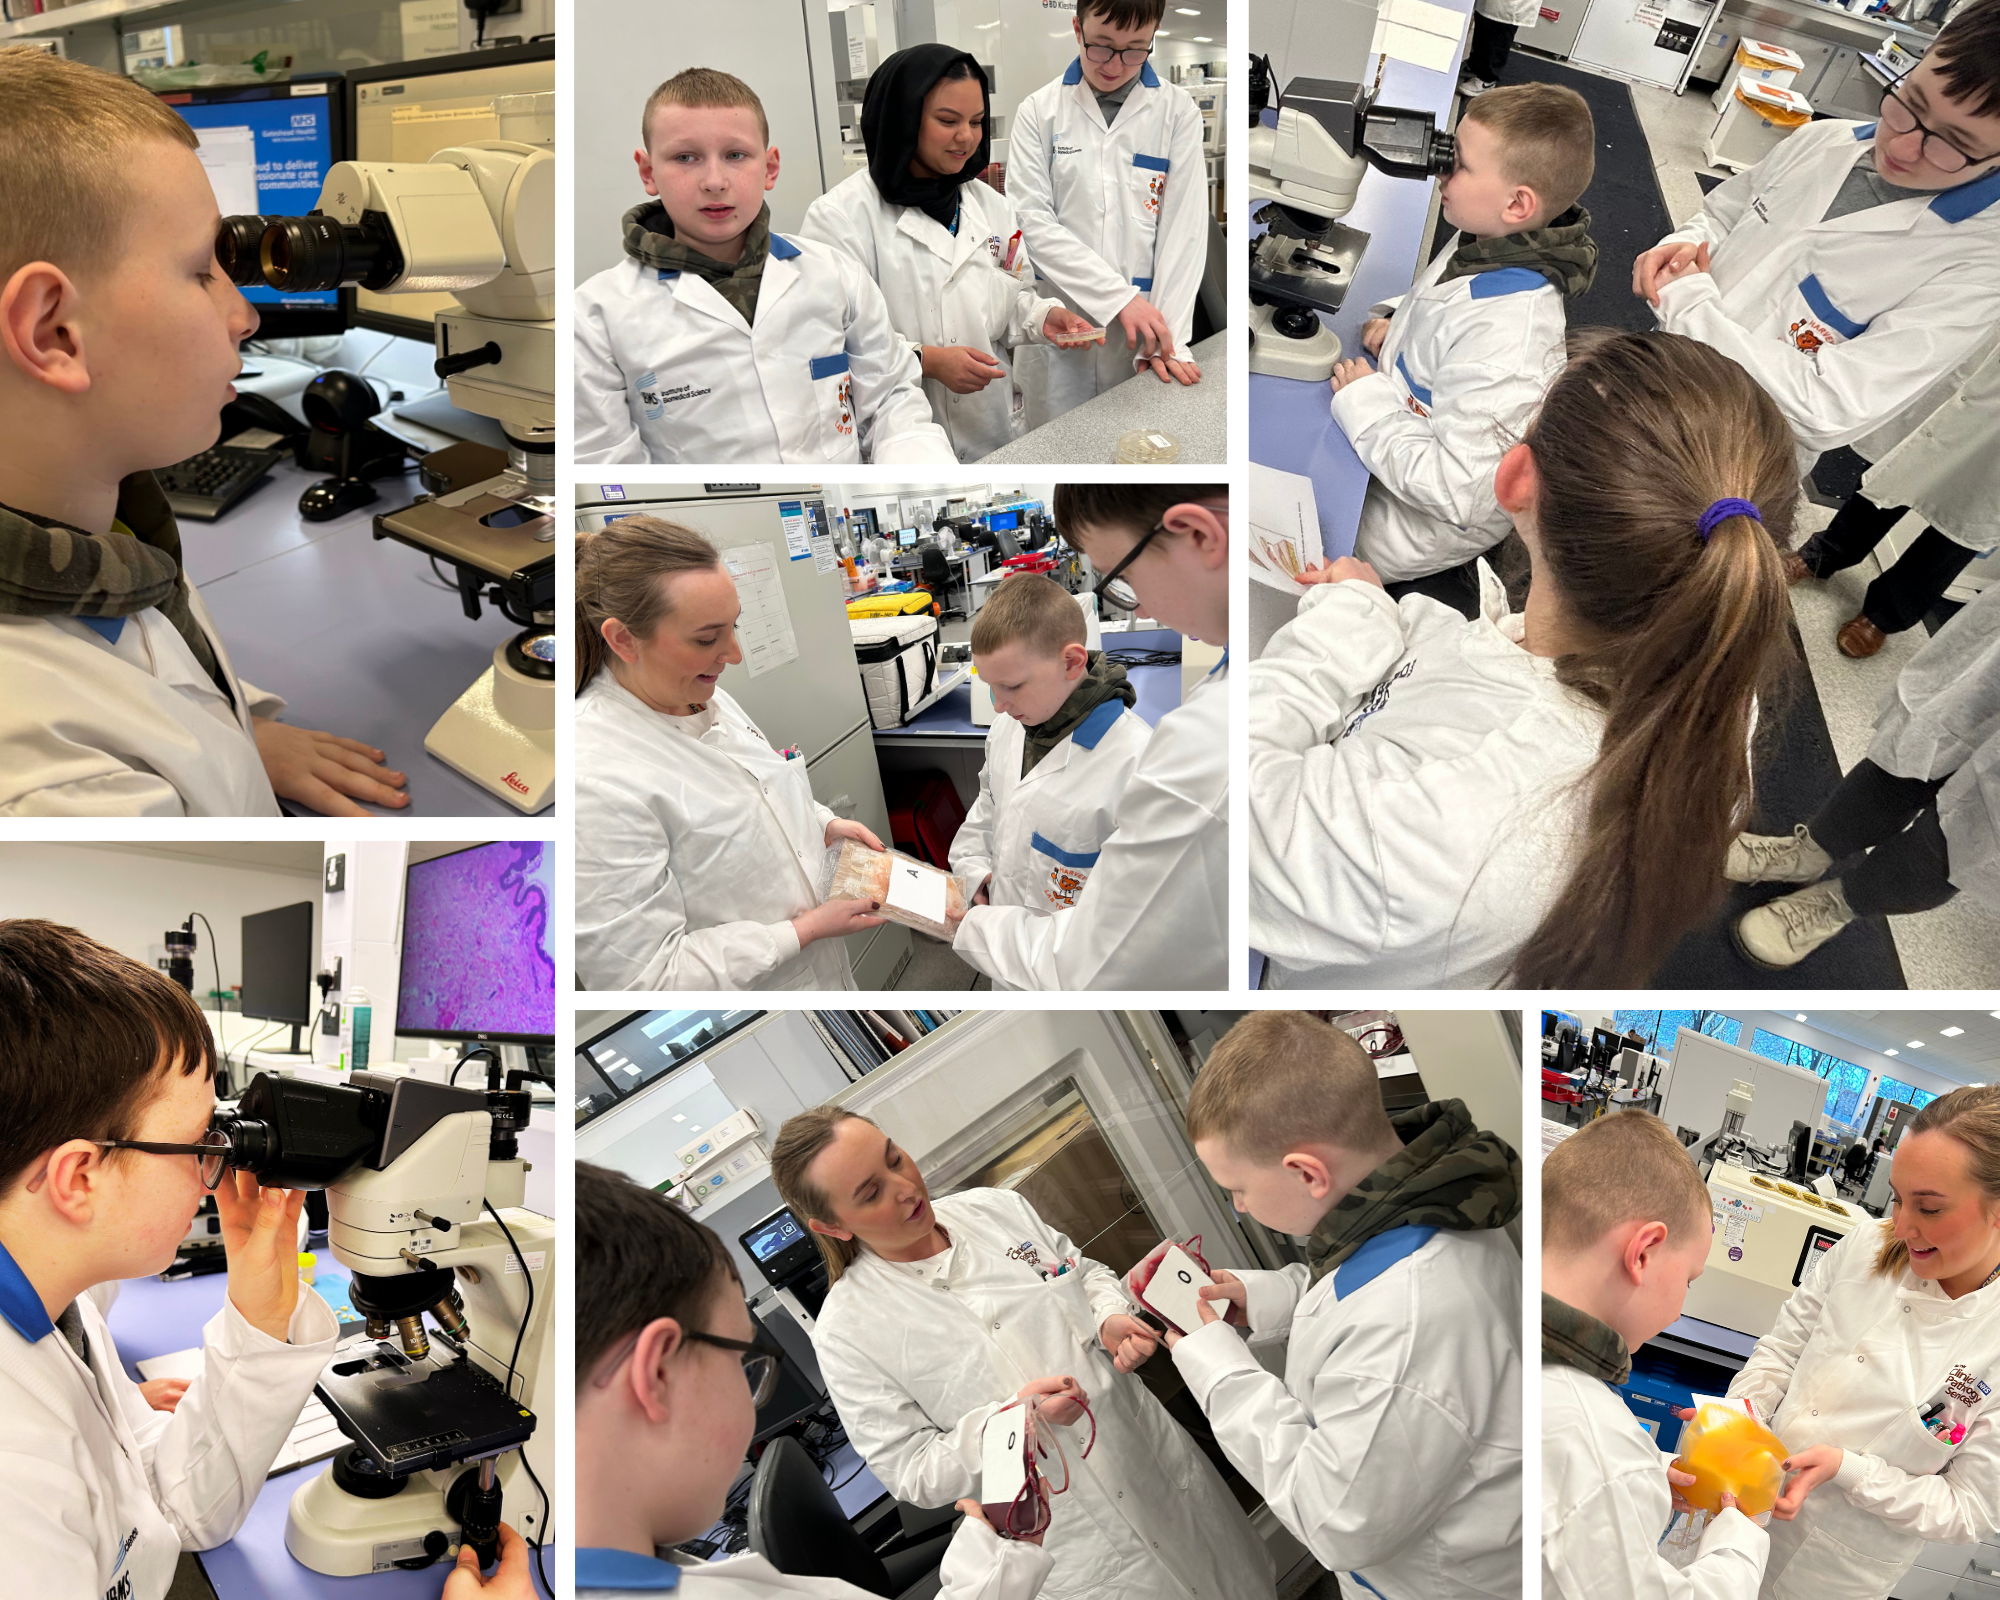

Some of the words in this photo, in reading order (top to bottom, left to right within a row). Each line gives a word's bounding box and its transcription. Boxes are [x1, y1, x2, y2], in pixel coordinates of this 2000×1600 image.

[272, 162, 283, 171] to
[285, 160, 318, 170] deliver
[298, 171, 318, 179] care
[259, 180, 321, 190] communities.
[661, 386, 683, 397] Institute
[683, 384, 690, 392] of
[663, 393, 691, 404] Biomedical
[690, 388, 711, 398] Science
[500, 771, 530, 795] Leica
[906, 868, 919, 879] A
[1949, 1368, 1976, 1385] Clinic
[1977, 1380, 1992, 1396] NHS
